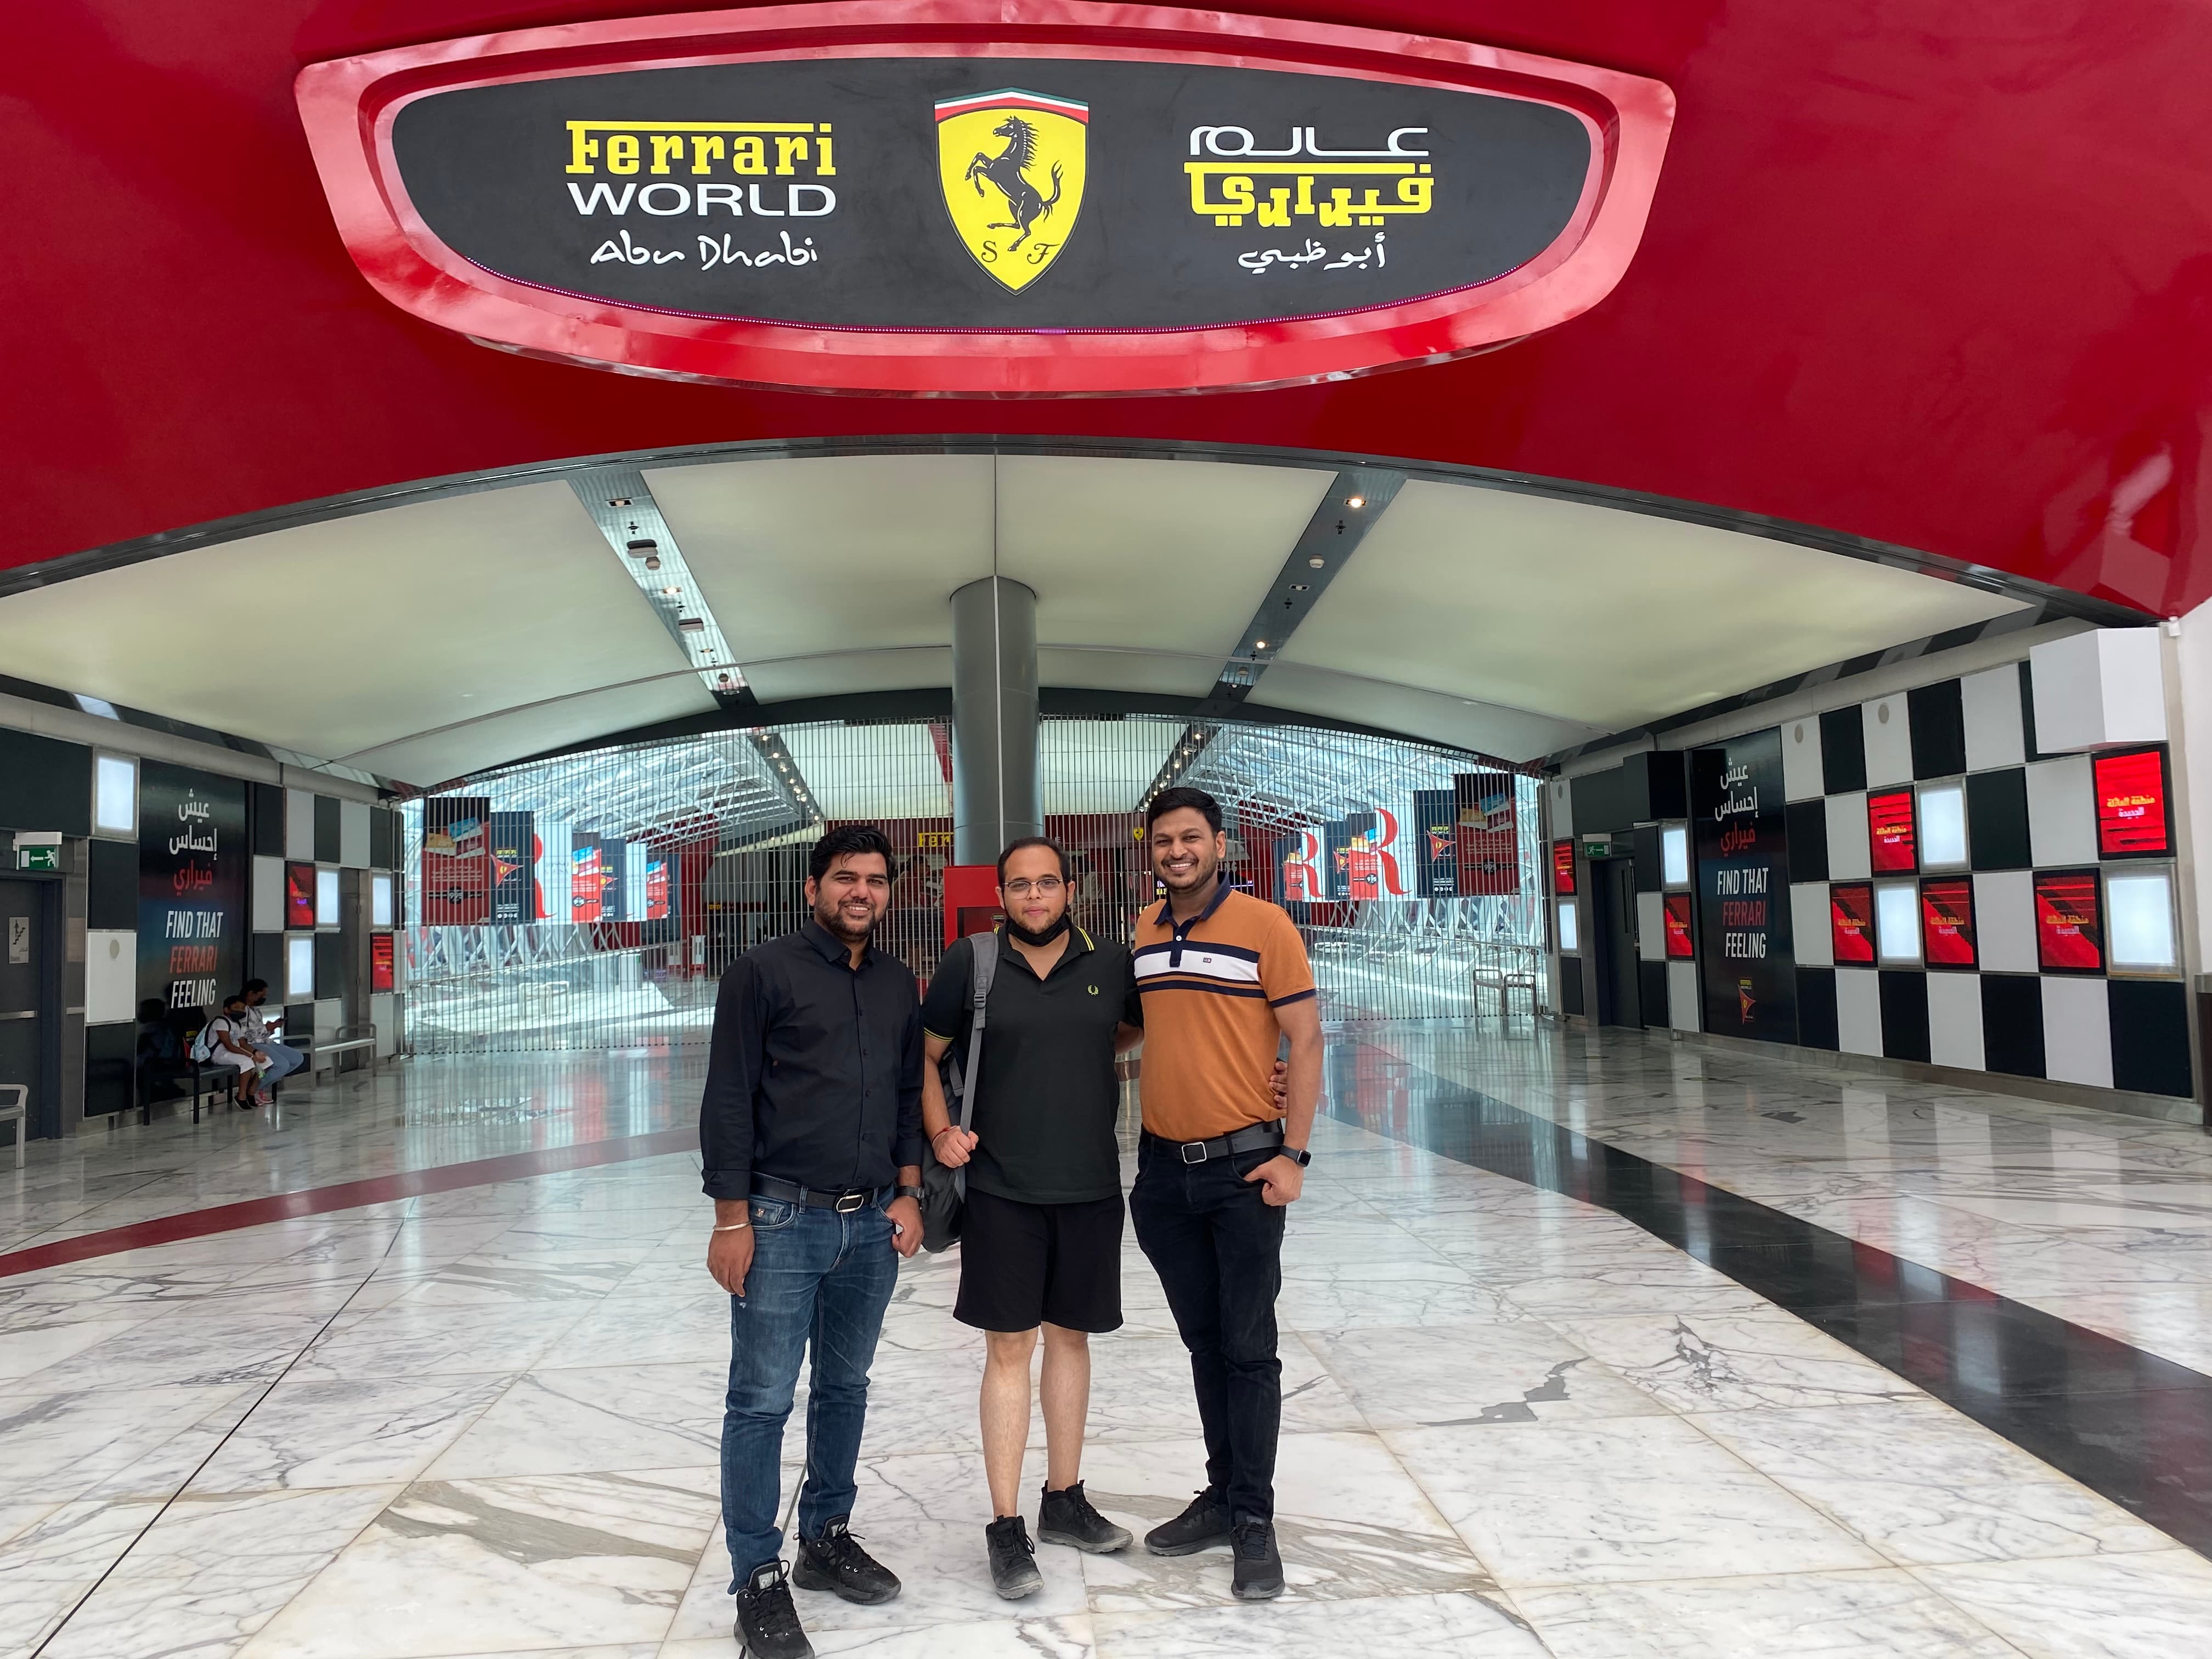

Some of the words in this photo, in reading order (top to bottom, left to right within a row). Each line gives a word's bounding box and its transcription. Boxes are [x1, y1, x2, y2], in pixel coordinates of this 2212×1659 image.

[566, 121, 837, 176] Ferrari
[1190, 126, 1429, 156] عالم
[566, 183, 837, 216] WORLD
[1184, 162, 1435, 228] فيراري
[590, 229, 685, 265] Abu
[697, 230, 818, 271] Dhabi
[981, 240, 997, 263] S
[1026, 243, 1060, 264] F
[1238, 238, 1327, 274] ظبي
[1323, 232, 1386, 270] أبو
[1720, 757, 1749, 790] عيش
[178, 788, 210, 823] عيش
[1715, 786, 1759, 822] إحساس
[169, 825, 218, 861] إحساس
[917, 832, 954, 847] Fer
[1720, 821, 1756, 857] فيراري
[173, 860, 213, 896] فيراري
[1717, 870, 1740, 895] FIND
[1742, 867, 1769, 894] THAT
[166, 911, 193, 938] FIND
[196, 912, 223, 938] THAT
[1723, 900, 1767, 926] FERRARI
[170, 945, 218, 974] FERRARI
[1725, 933, 1767, 959] FEELING
[171, 979, 217, 1009] FEELING
